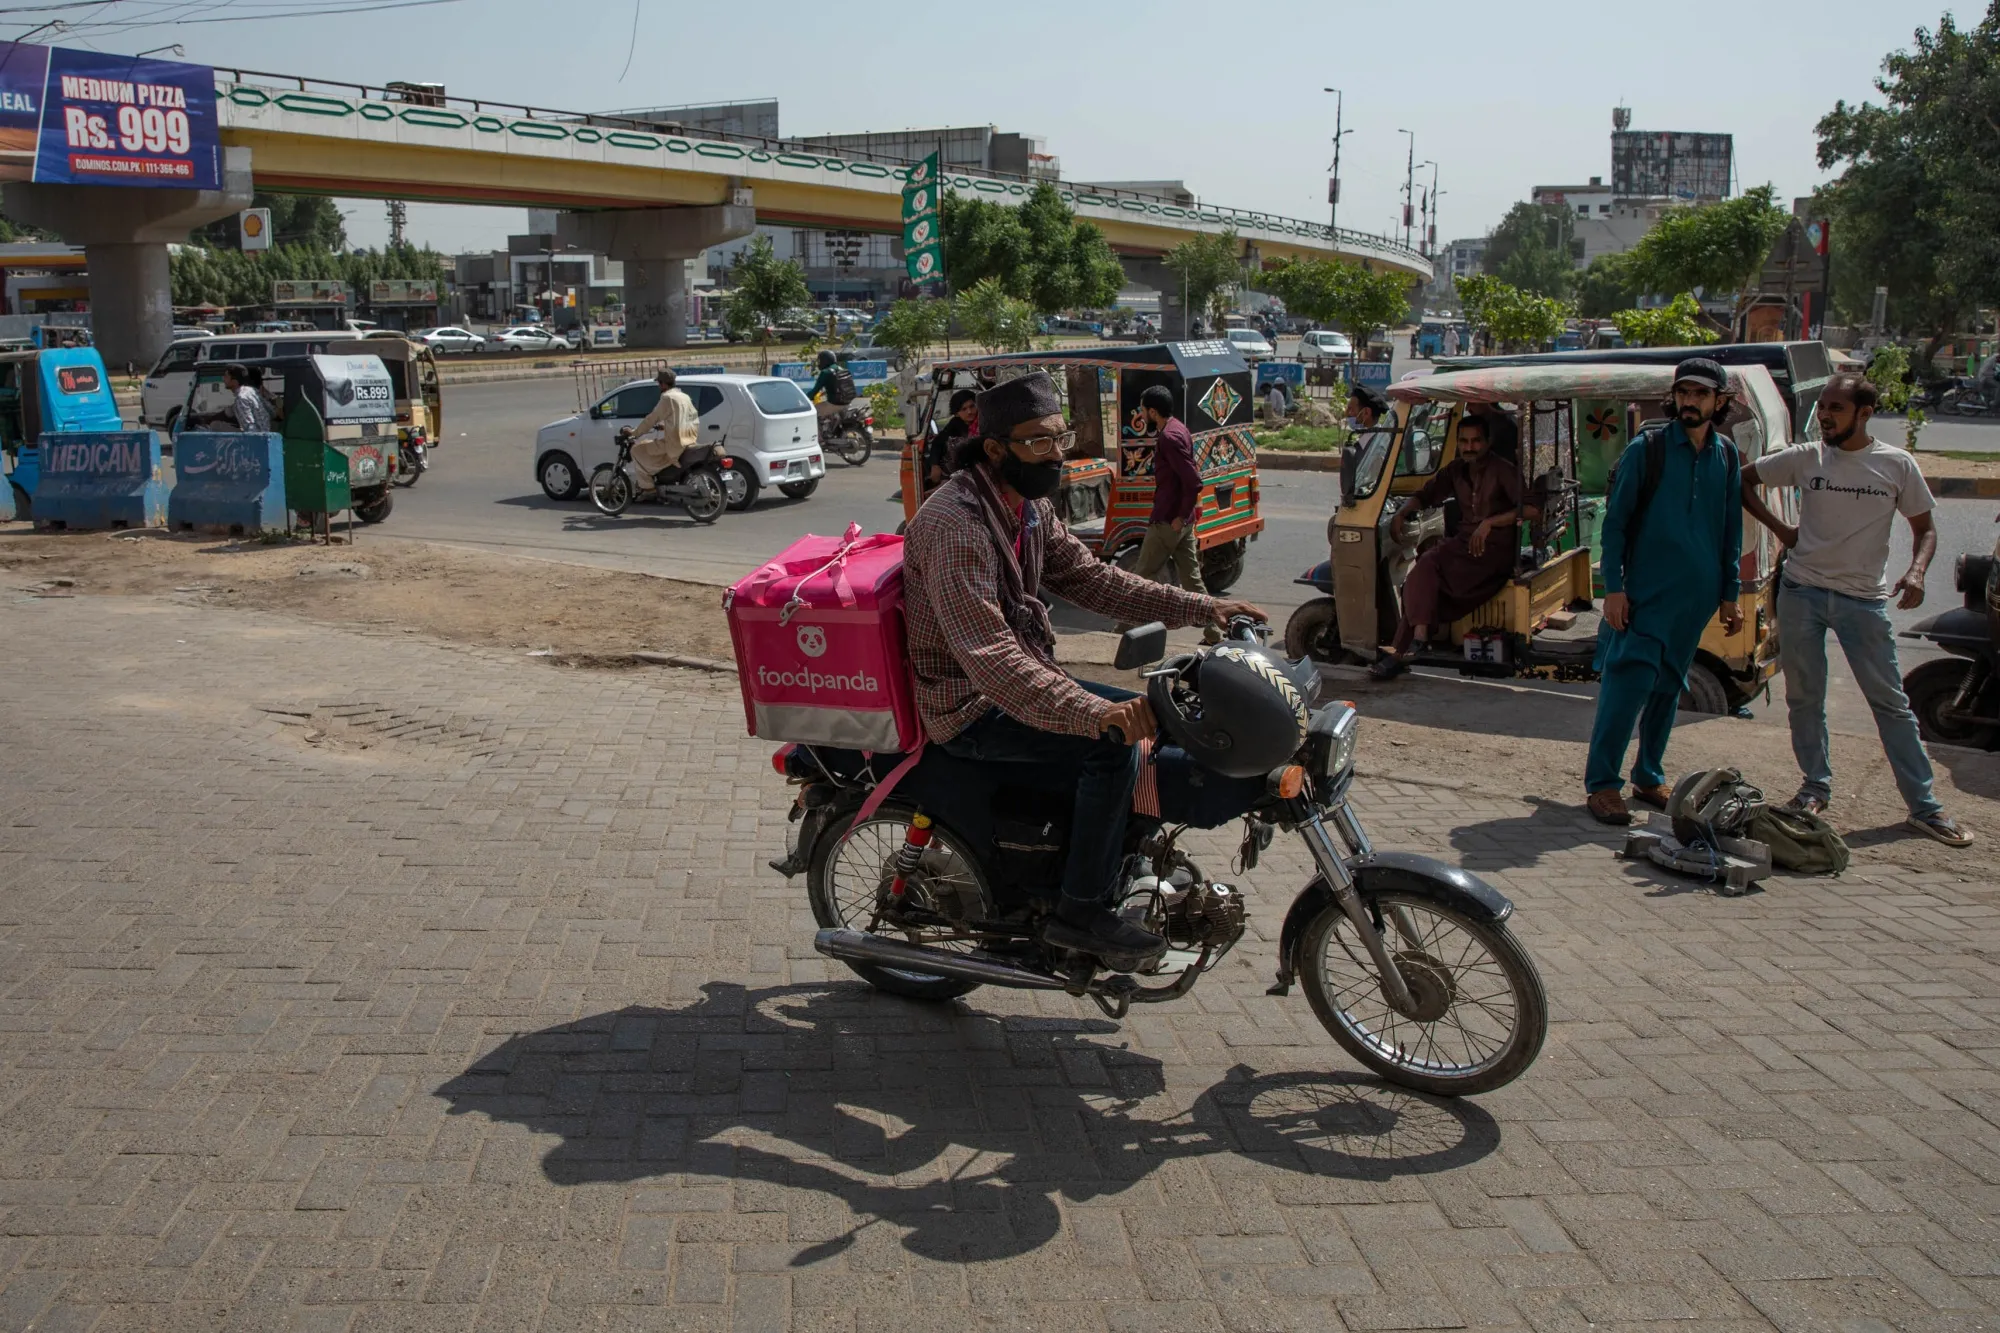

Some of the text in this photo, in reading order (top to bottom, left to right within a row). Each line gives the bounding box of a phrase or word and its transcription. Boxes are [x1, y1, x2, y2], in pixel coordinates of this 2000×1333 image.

[61, 76, 187, 108] MEDIUM PIZZA
[64, 106, 190, 154] Rs. 999
[75, 159, 189, 175] DOMINOS.COM.PK 111-366-466
[356, 386, 388, 400] Rs.899
[51, 442, 141, 473] MEDICAM
[1809, 476, 1889, 500] Champion
[757, 665, 878, 694] foodpanda
